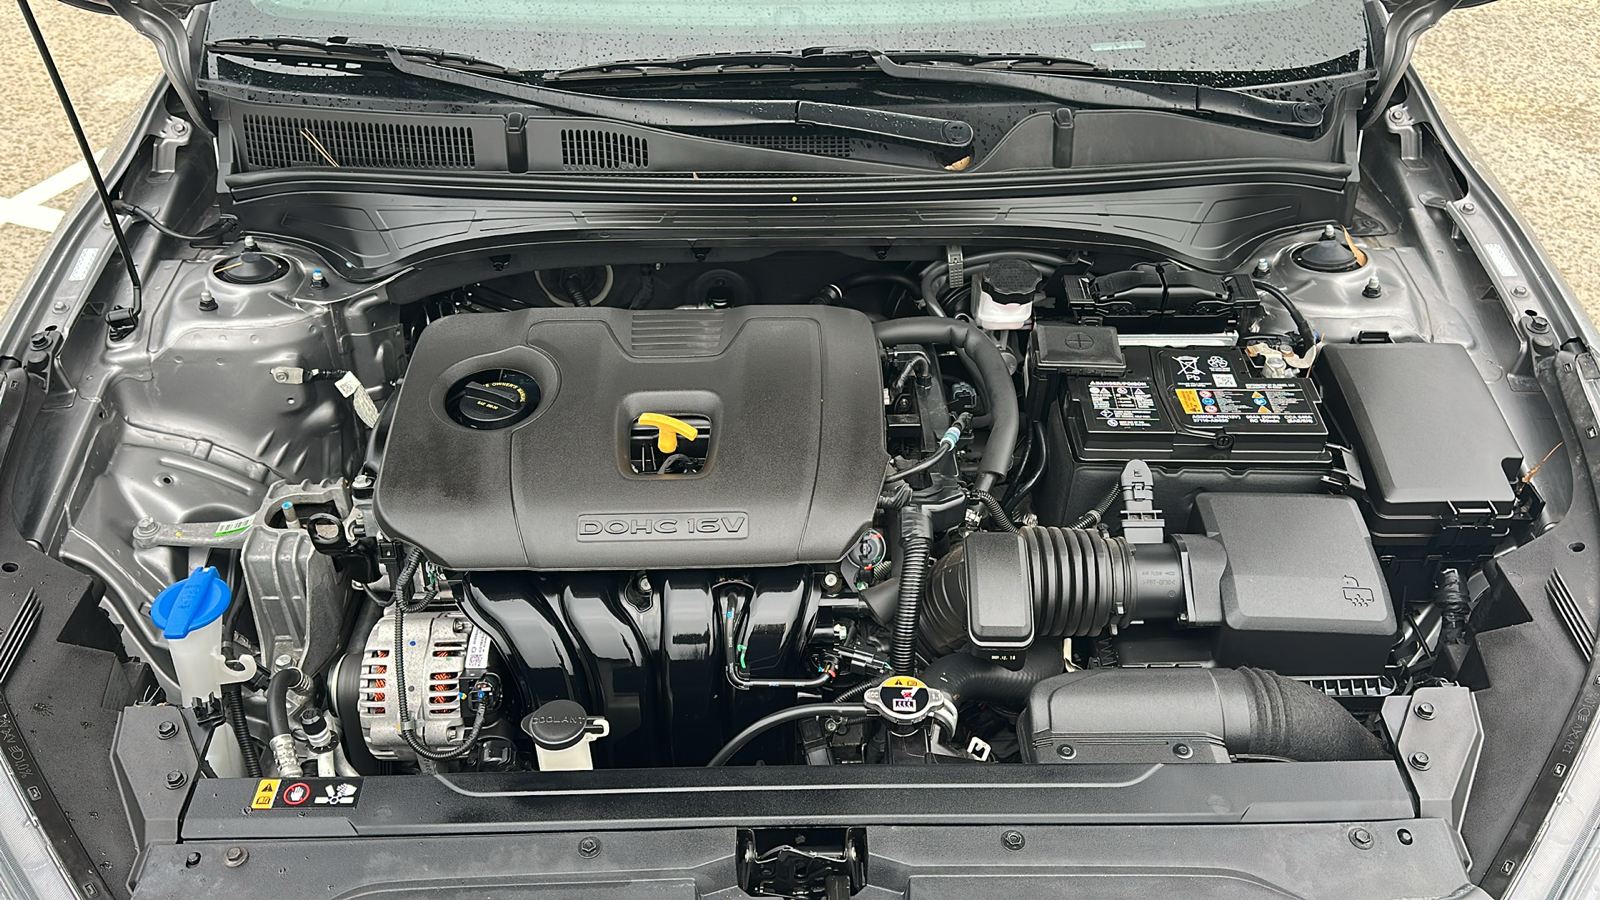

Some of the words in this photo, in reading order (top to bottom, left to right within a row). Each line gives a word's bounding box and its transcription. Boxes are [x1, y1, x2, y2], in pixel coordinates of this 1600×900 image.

[579, 519, 678, 535] DOHC
[687, 517, 745, 533] 16V
[532, 716, 586, 725] COOLANT
